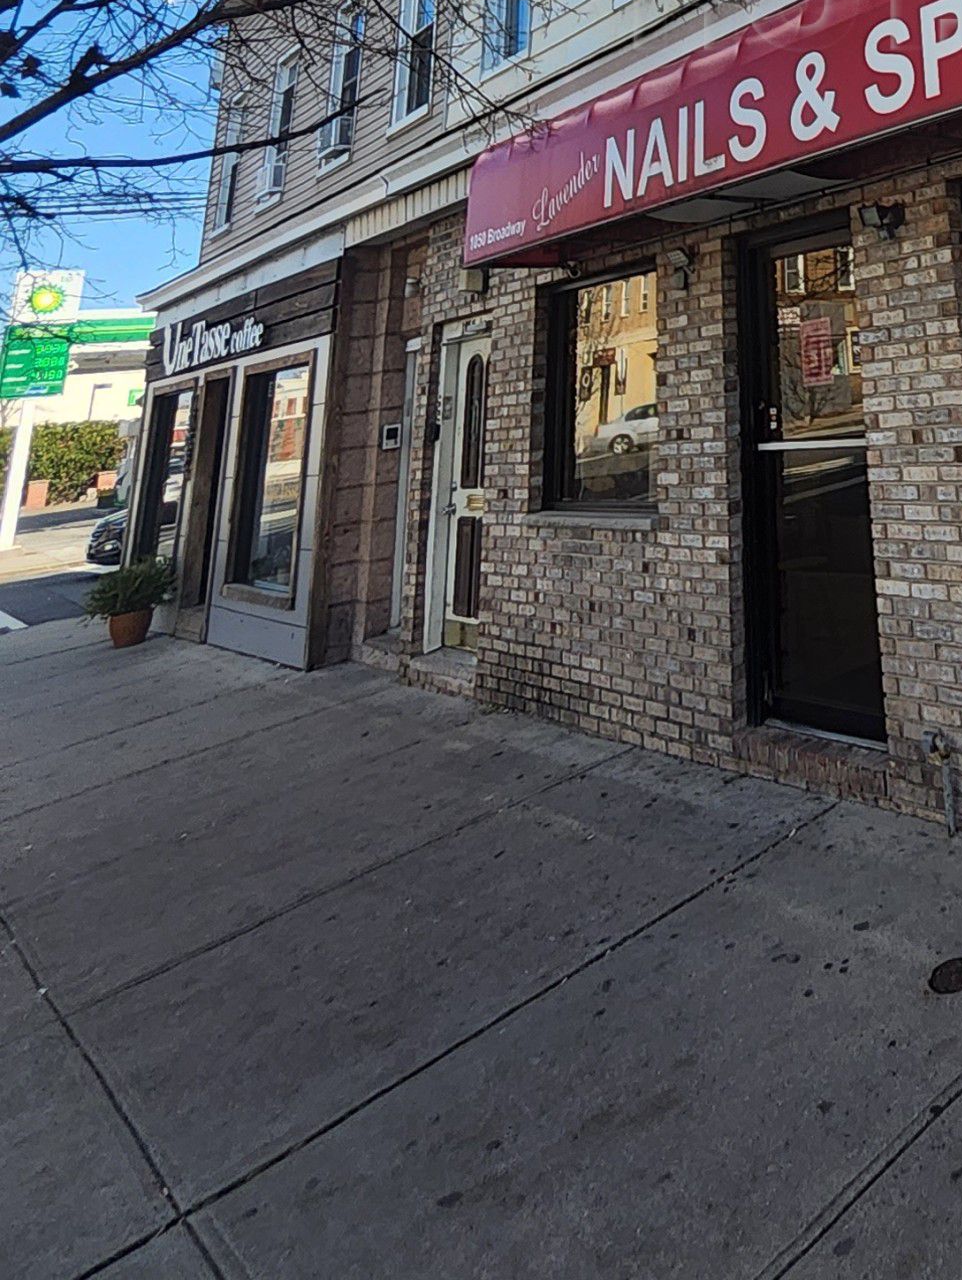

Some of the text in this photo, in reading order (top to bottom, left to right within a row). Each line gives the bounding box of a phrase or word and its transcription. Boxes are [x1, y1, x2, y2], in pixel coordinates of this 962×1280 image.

[533, 150, 600, 231] Lavender
[604, 77, 766, 208] NAILS
[790, 51, 840, 142] &
[487, 219, 526, 244] Broadway
[191, 320, 230, 365] Tasse
[230, 317, 264, 354] coffee
